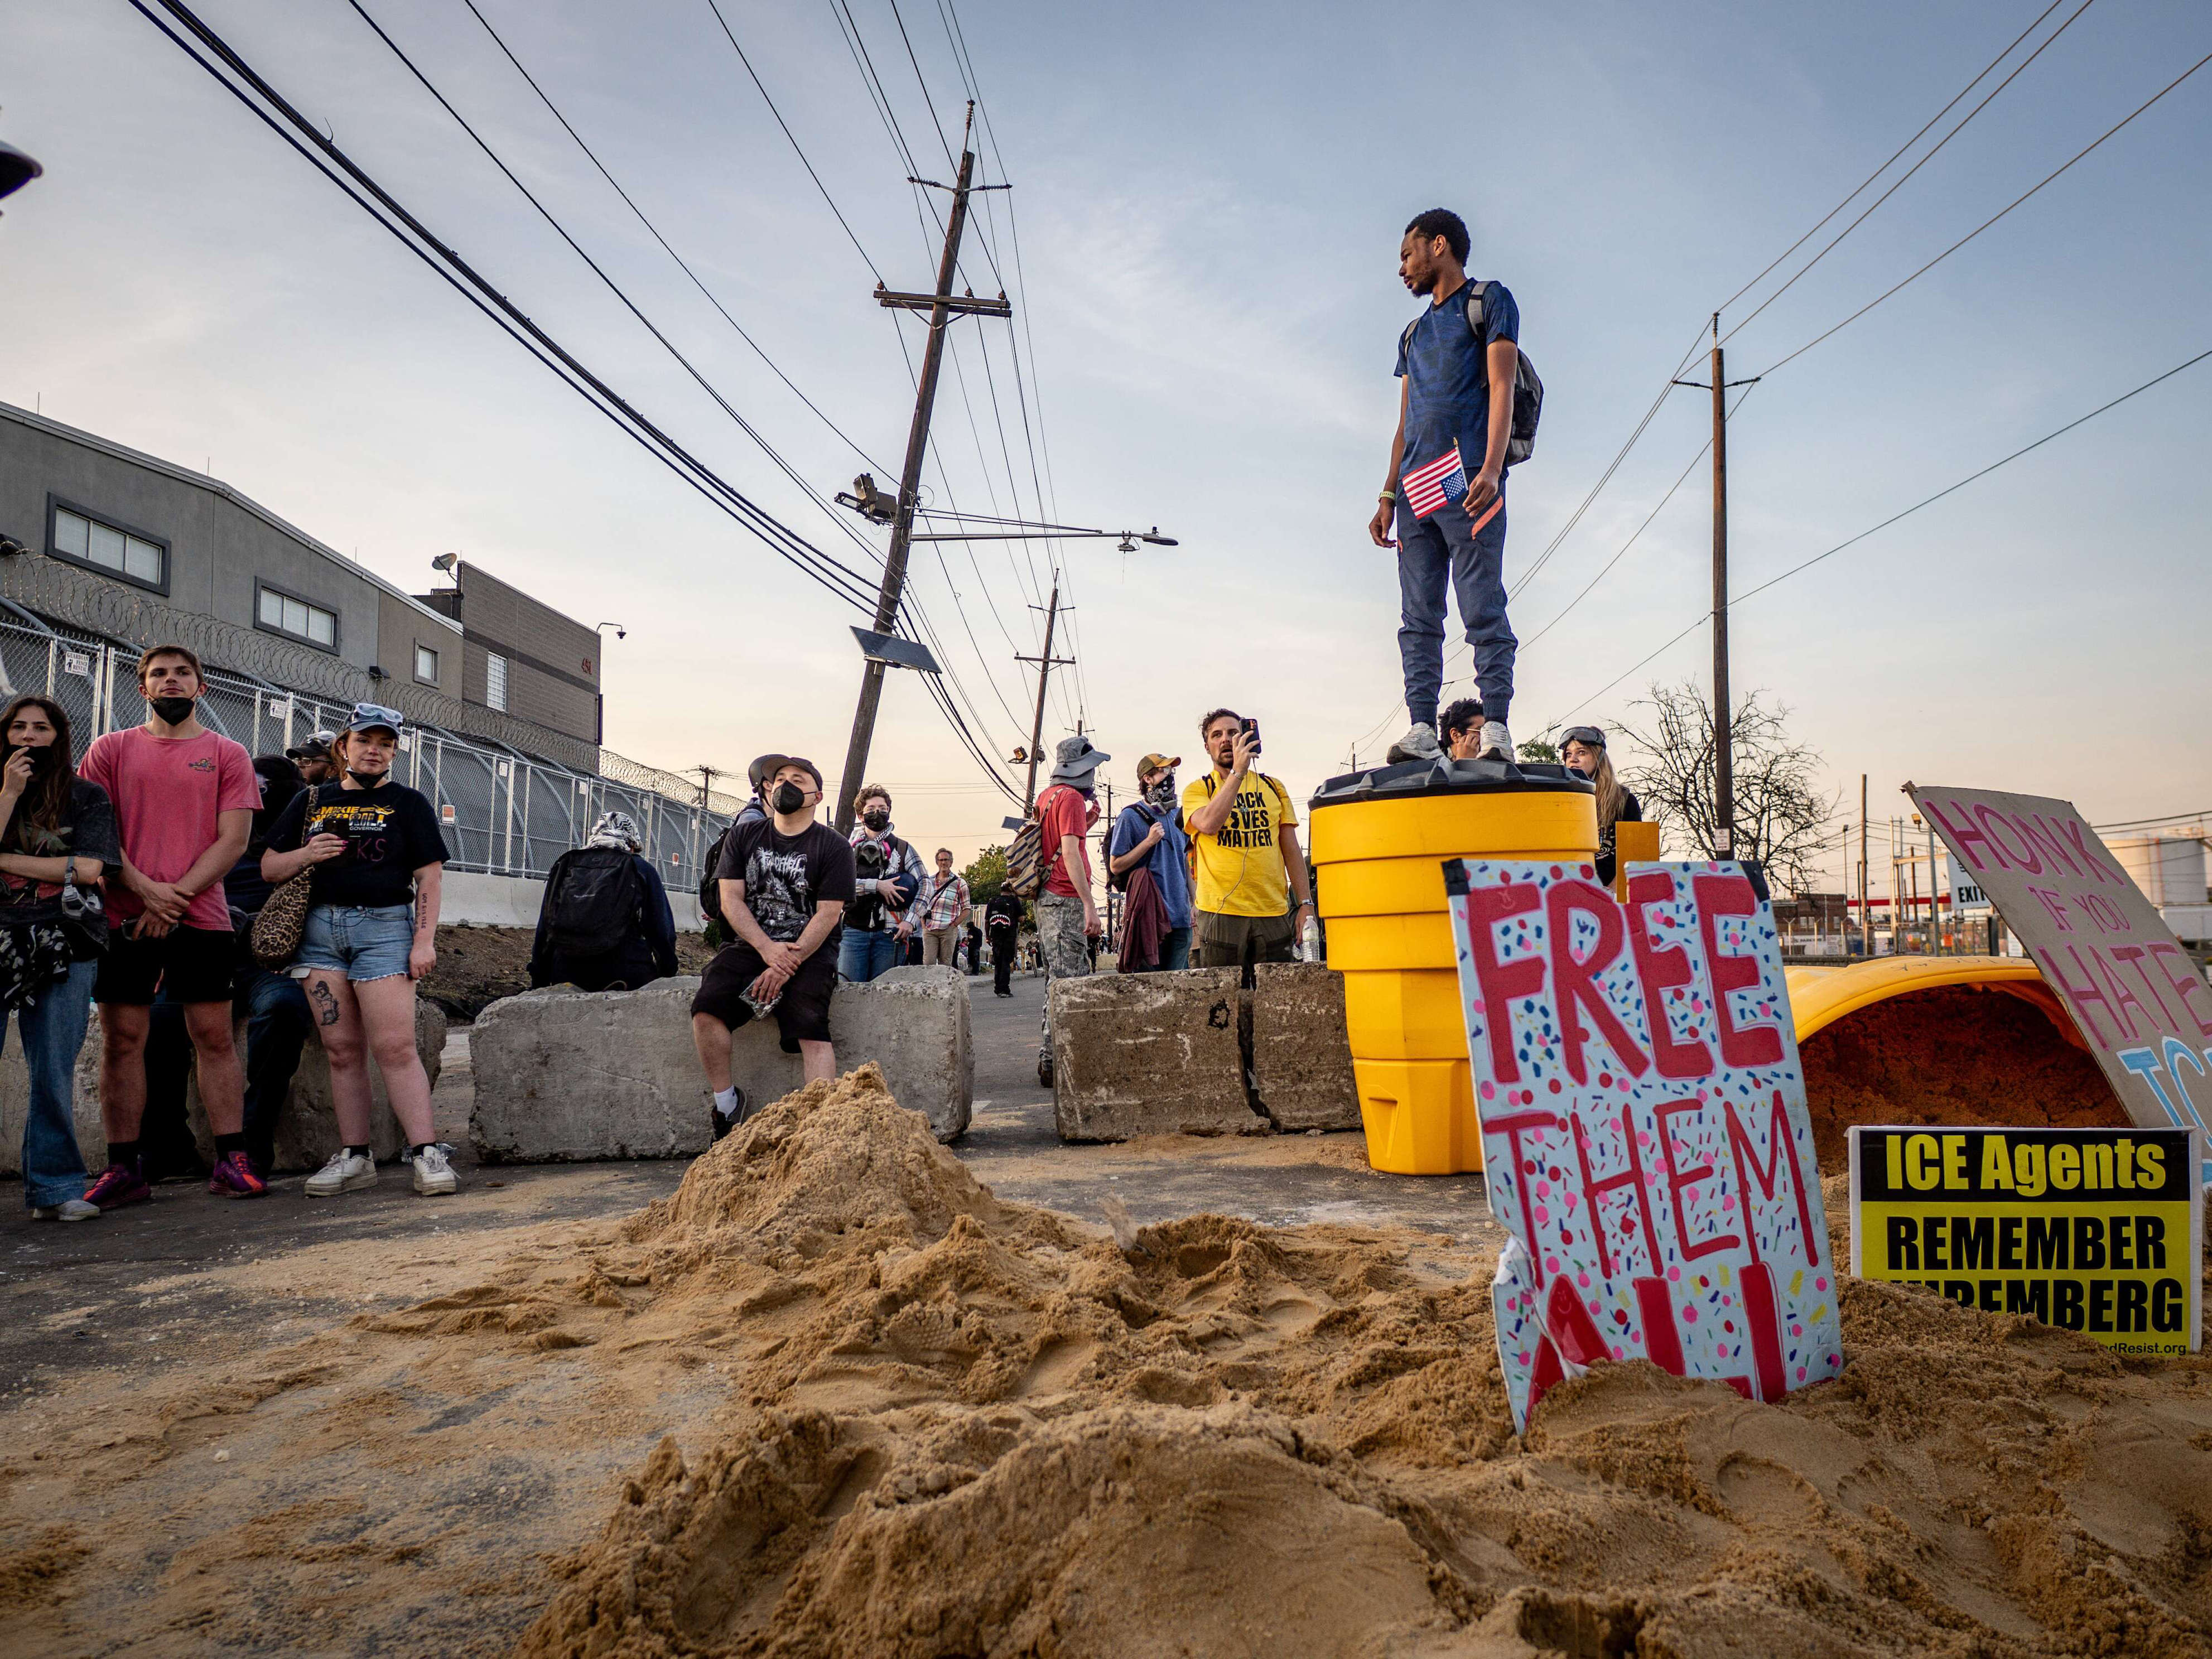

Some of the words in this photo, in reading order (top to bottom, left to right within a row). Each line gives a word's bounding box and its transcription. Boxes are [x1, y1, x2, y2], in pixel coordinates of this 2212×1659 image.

[67, 653, 89, 661] GUARDIAN
[319, 806, 360, 814] MIKIE
[1233, 792, 1266, 808] ACK
[1217, 829, 1273, 847] MATTER
[1922, 798, 2127, 888] HONK
[2026, 885, 2076, 935] IF
[2071, 894, 2131, 935] YOU
[1466, 870, 1785, 1087] FREE
[2037, 941, 2212, 1052] HATE
[1483, 1089, 1819, 1291] THEM
[1886, 1134, 1969, 1191] ICE
[1980, 1134, 2166, 1197] Agents
[1887, 1216, 2167, 1271] REMEMBER
[1889, 1278, 2183, 1333] EMBERG
